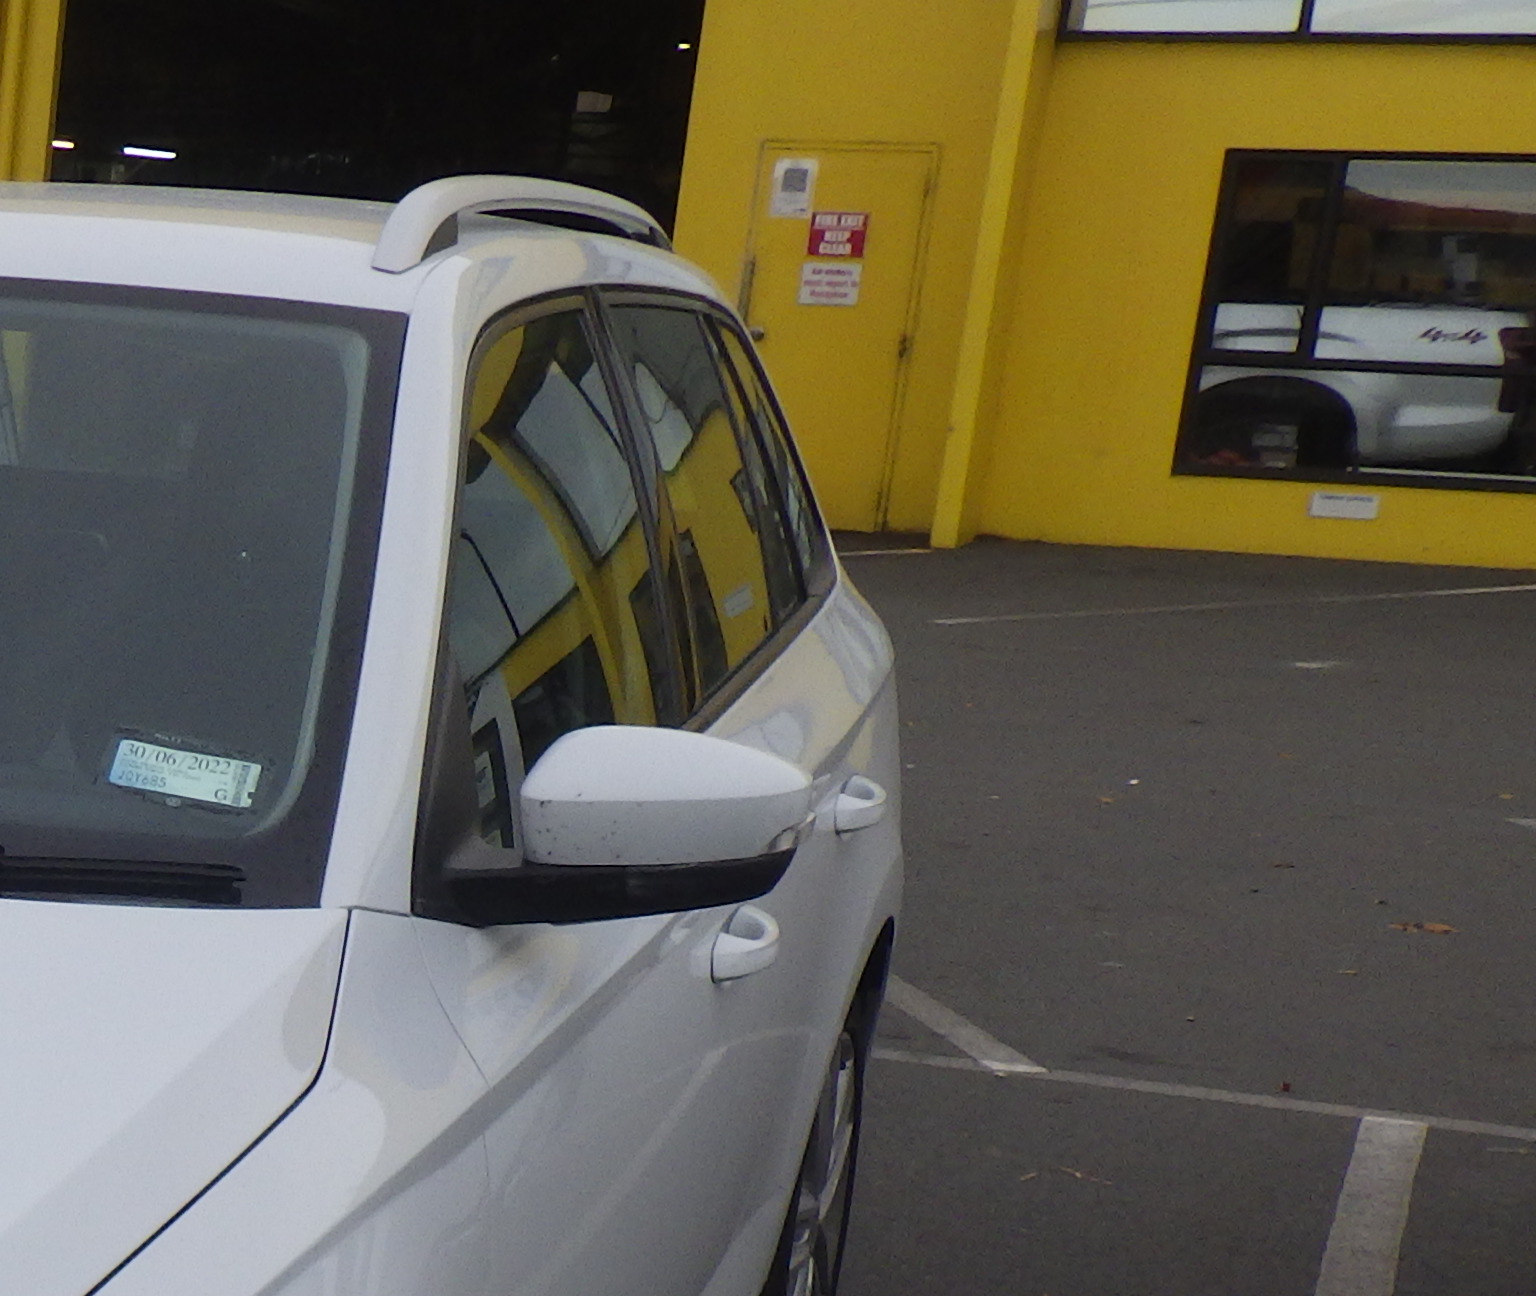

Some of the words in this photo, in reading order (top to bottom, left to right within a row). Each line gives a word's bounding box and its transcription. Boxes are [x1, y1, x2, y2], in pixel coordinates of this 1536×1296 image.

[123, 743, 231, 775] 30/06/2022
[117, 769, 167, 788] JQY685
[214, 788, 227, 801] G
